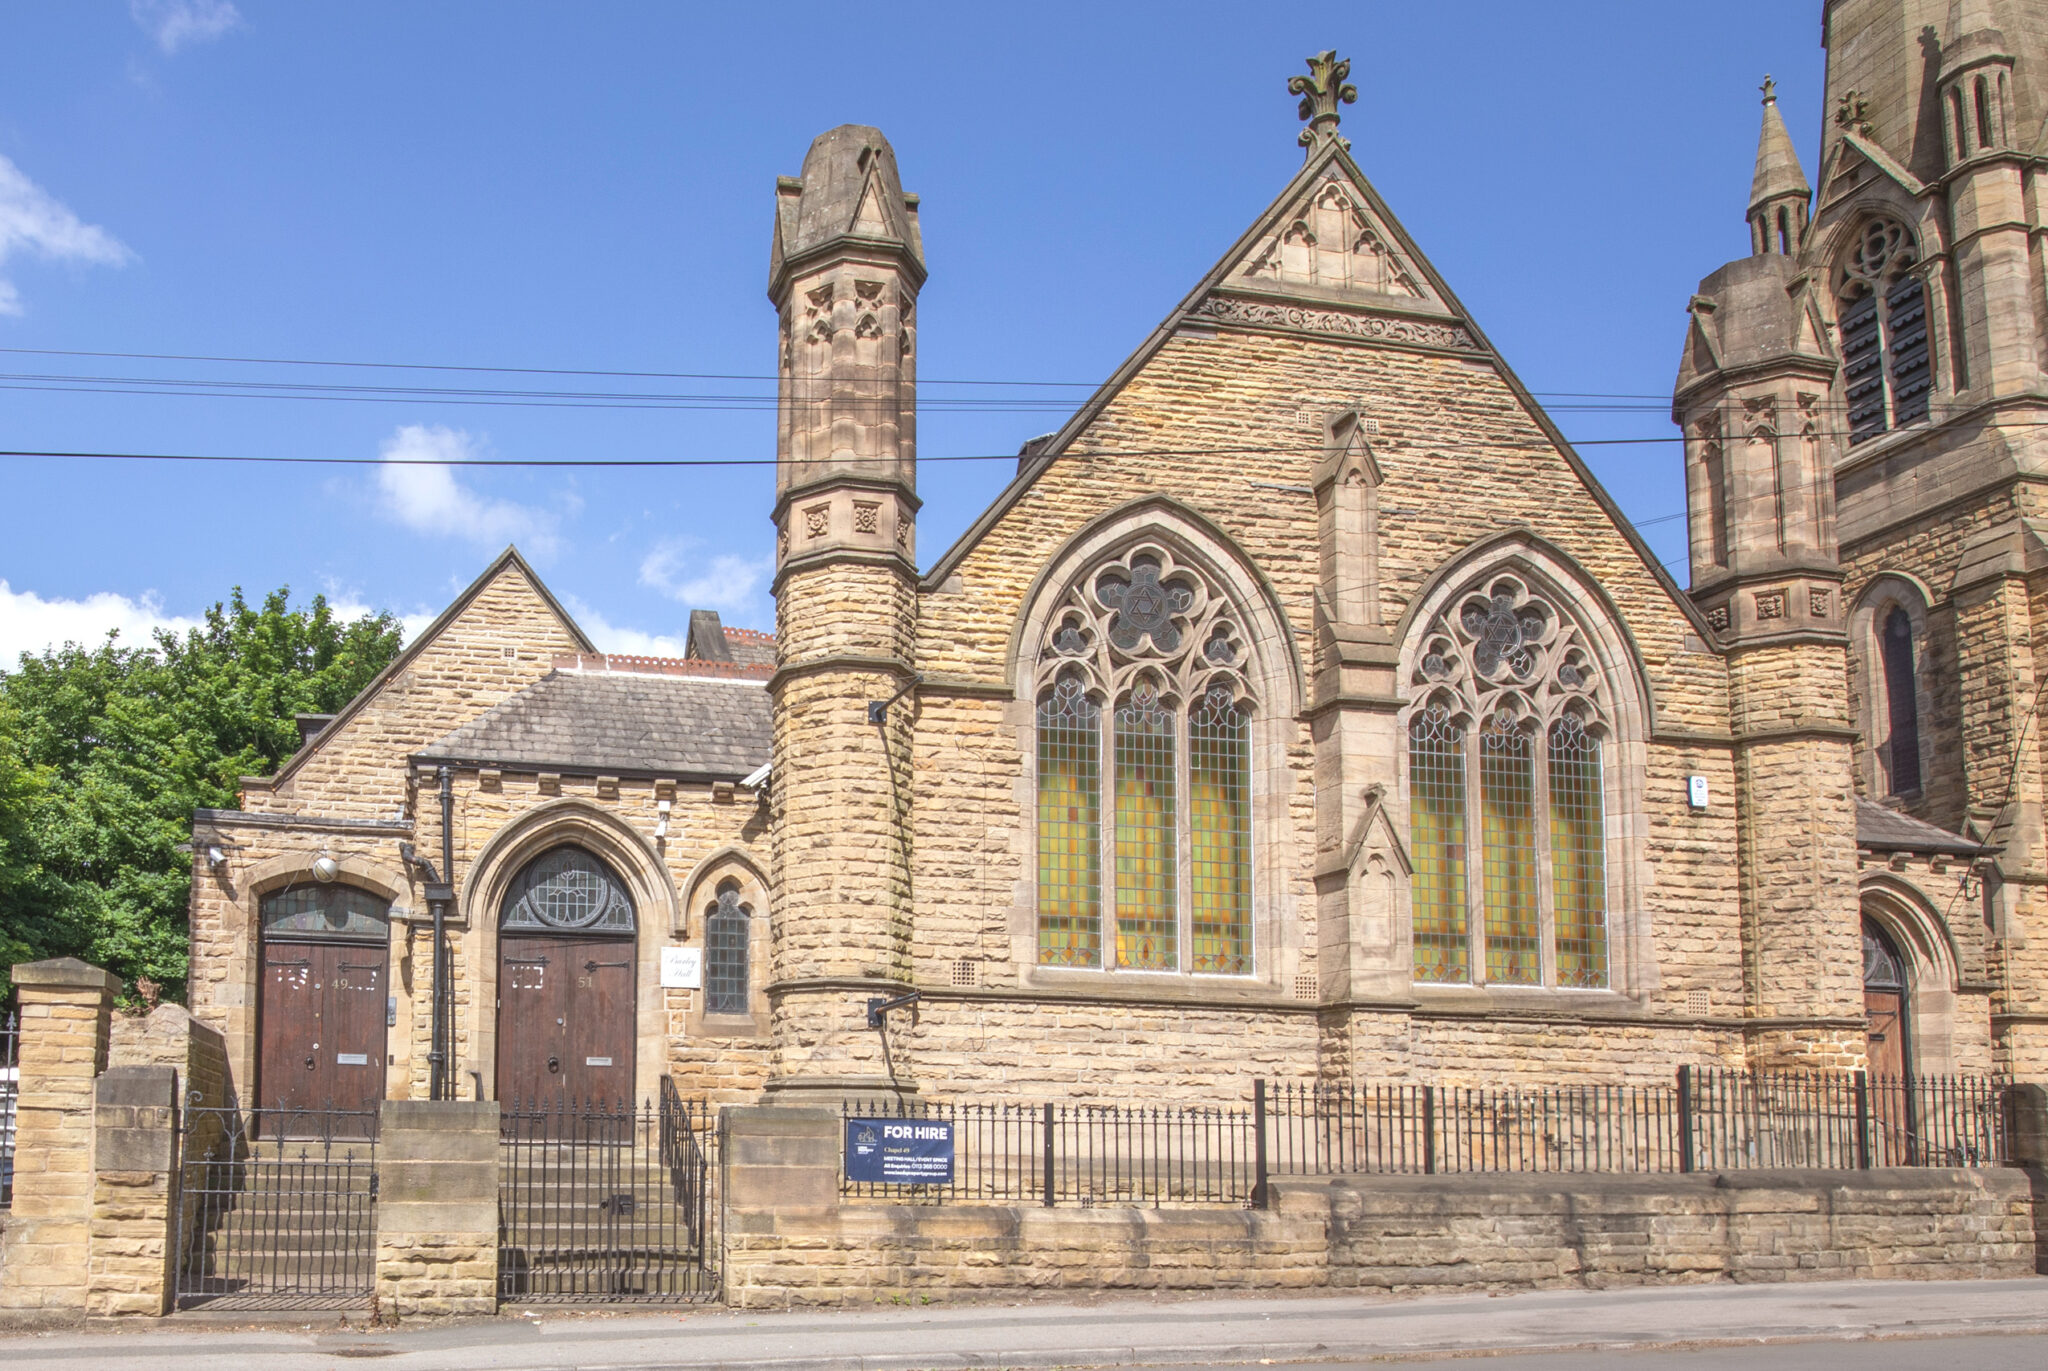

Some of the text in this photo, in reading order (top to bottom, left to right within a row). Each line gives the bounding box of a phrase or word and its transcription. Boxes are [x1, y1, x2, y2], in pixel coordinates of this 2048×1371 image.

[331, 978, 348, 990] 49
[578, 976, 592, 988] 51
[884, 1125, 948, 1140] FOR HIRE
